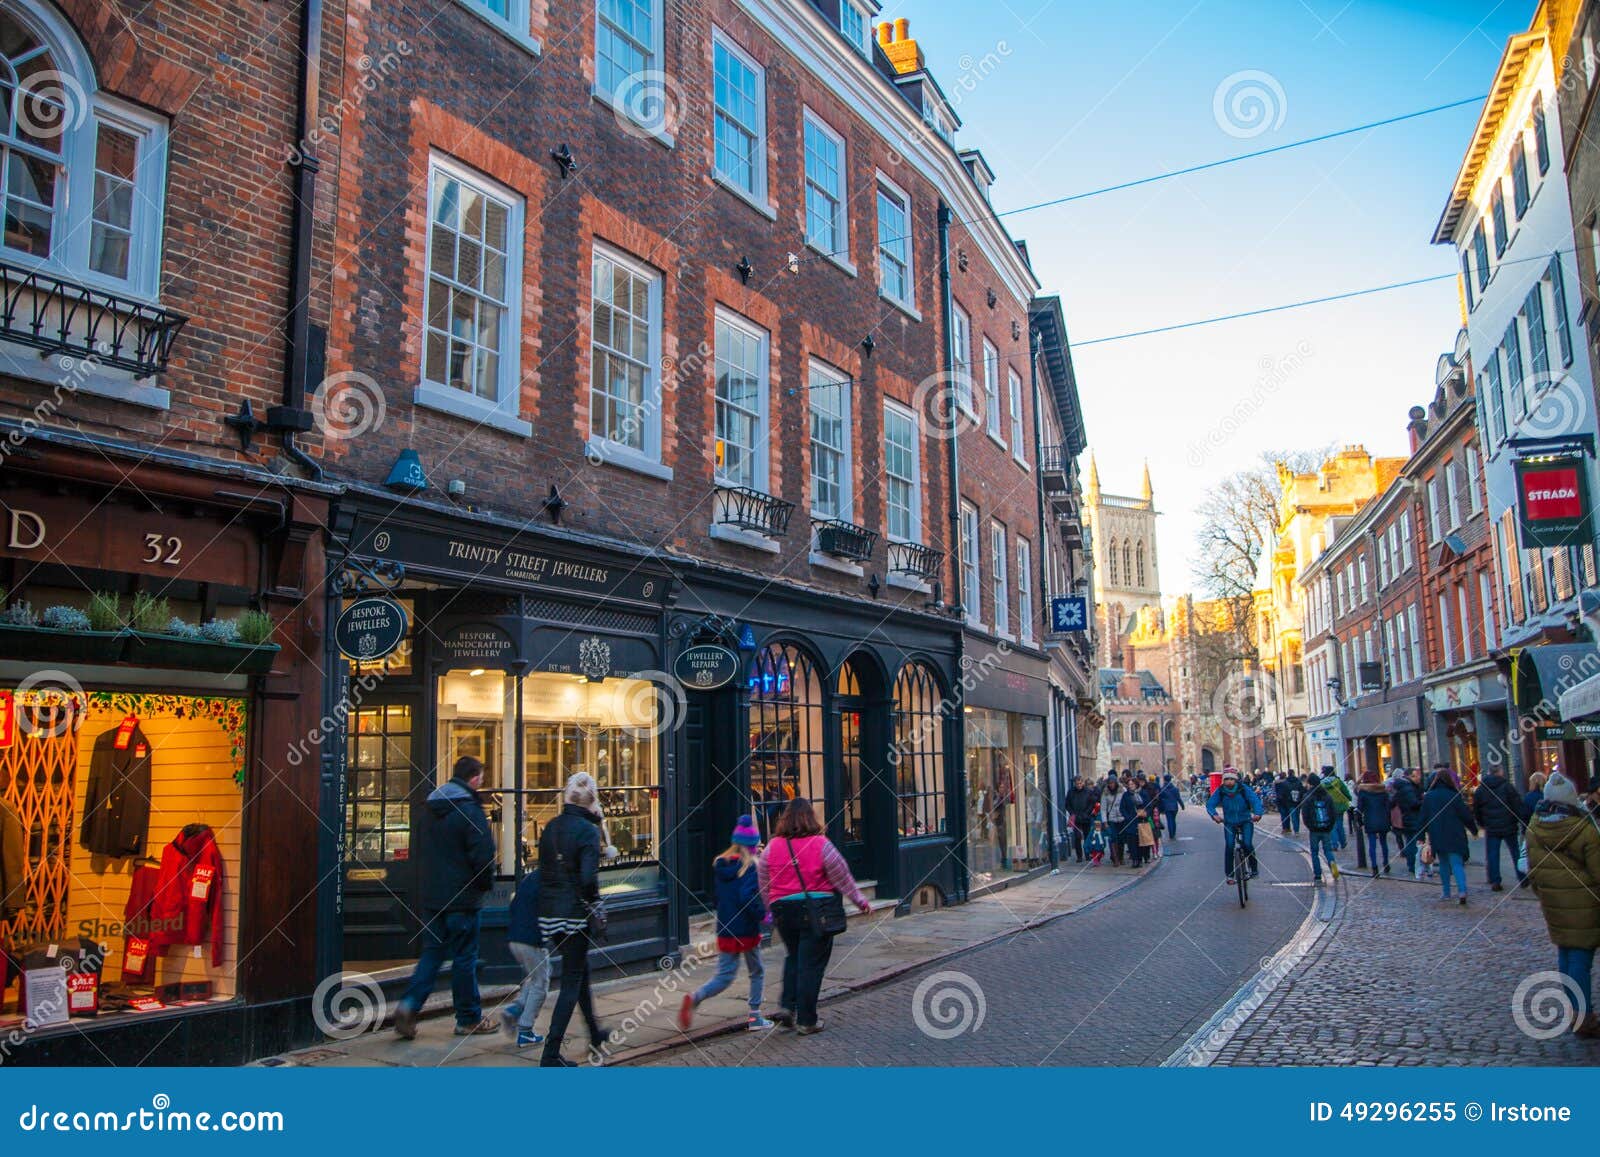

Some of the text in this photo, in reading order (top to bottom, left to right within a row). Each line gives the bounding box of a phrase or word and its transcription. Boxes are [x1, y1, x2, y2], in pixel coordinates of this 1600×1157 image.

[1528, 488, 1575, 501] STRADA
[143, 533, 183, 565] 32
[448, 541, 608, 583] TRINITY STREET JEWELLERS
[505, 569, 540, 581] CAMBRIDGE
[352, 606, 386, 619] BESPOKE
[347, 617, 390, 633] JEWELLERS
[459, 632, 497, 640] BESPOKE
[444, 640, 511, 649] HANDCRAFTED
[454, 649, 500, 658] JEWELLERY
[687, 652, 724, 660] JEWELLERY
[691, 661, 719, 669] REPAIRS
[340, 676, 348, 744] TRINITY
[196, 868, 212, 877] SALE
[336, 824, 345, 914] JEWELLERS
[78, 912, 184, 938] Shepherd
[131, 942, 147, 951] SALE
[72, 977, 95, 986] SALE
